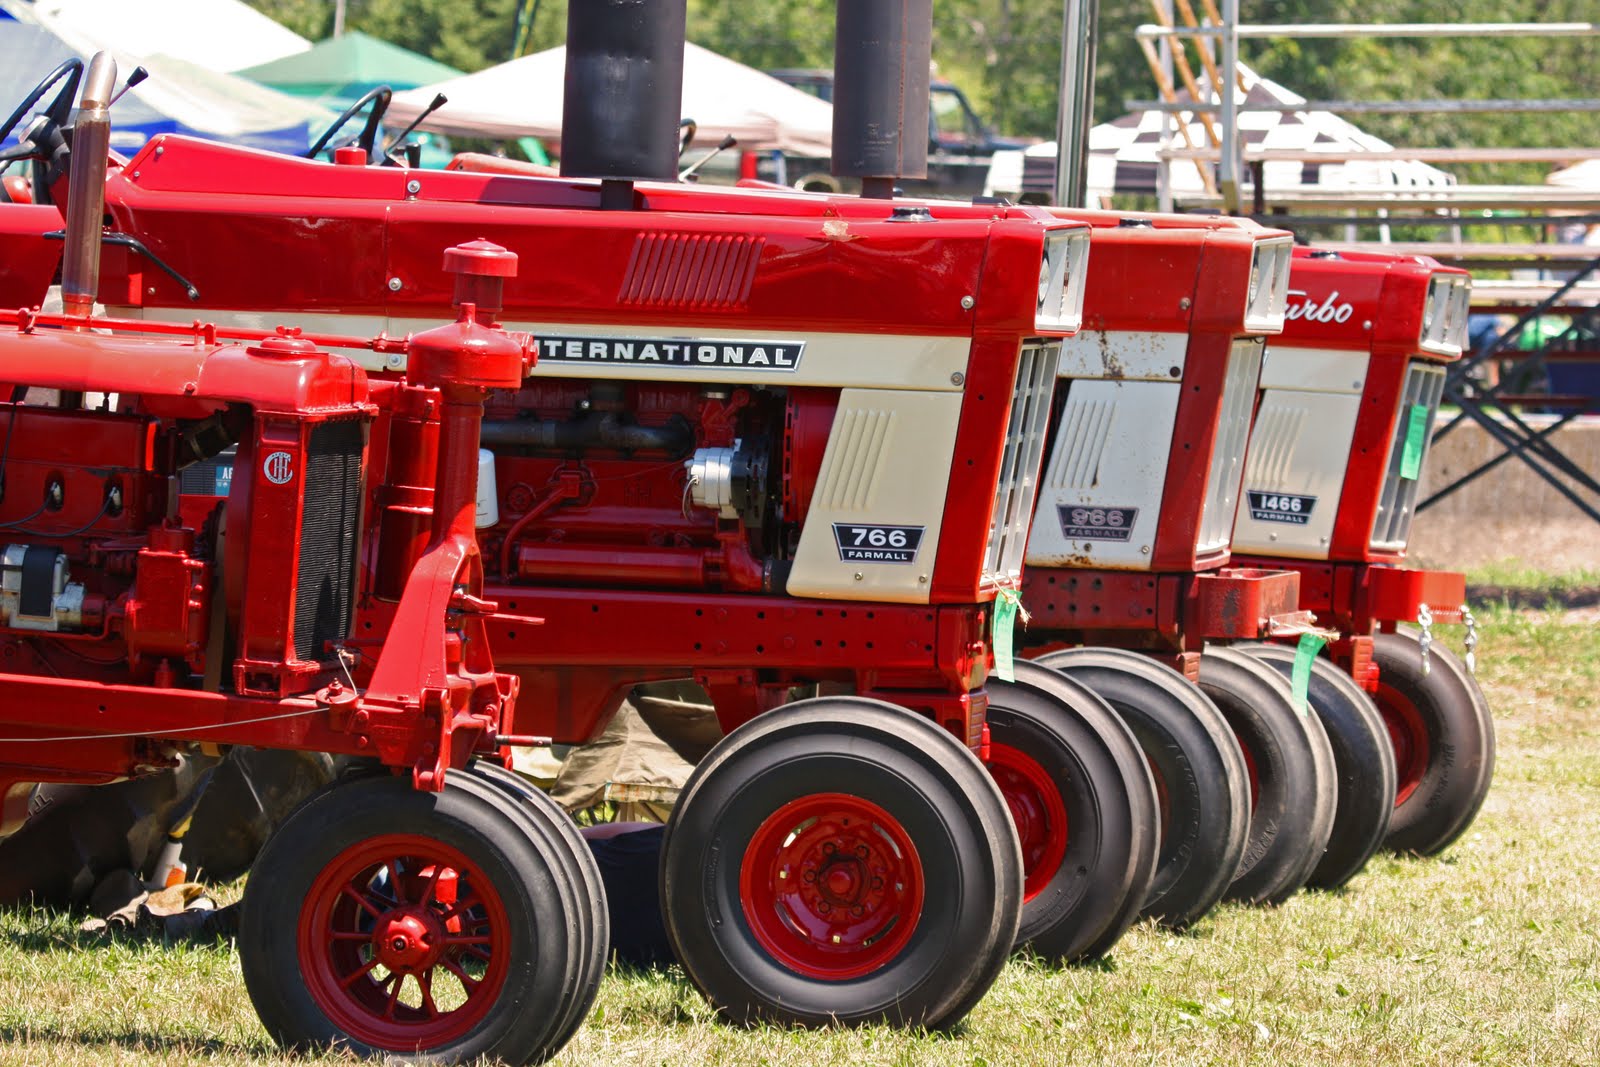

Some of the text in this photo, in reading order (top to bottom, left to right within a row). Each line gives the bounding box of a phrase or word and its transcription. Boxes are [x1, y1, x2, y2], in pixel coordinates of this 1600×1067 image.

[1261, 495, 1302, 512] 1466
[1071, 508, 1124, 527] 966
[1256, 512, 1304, 523] FARMALL
[851, 528, 907, 547] 766
[1069, 528, 1125, 538] FARMALL
[848, 551, 908, 560] FARMALL
